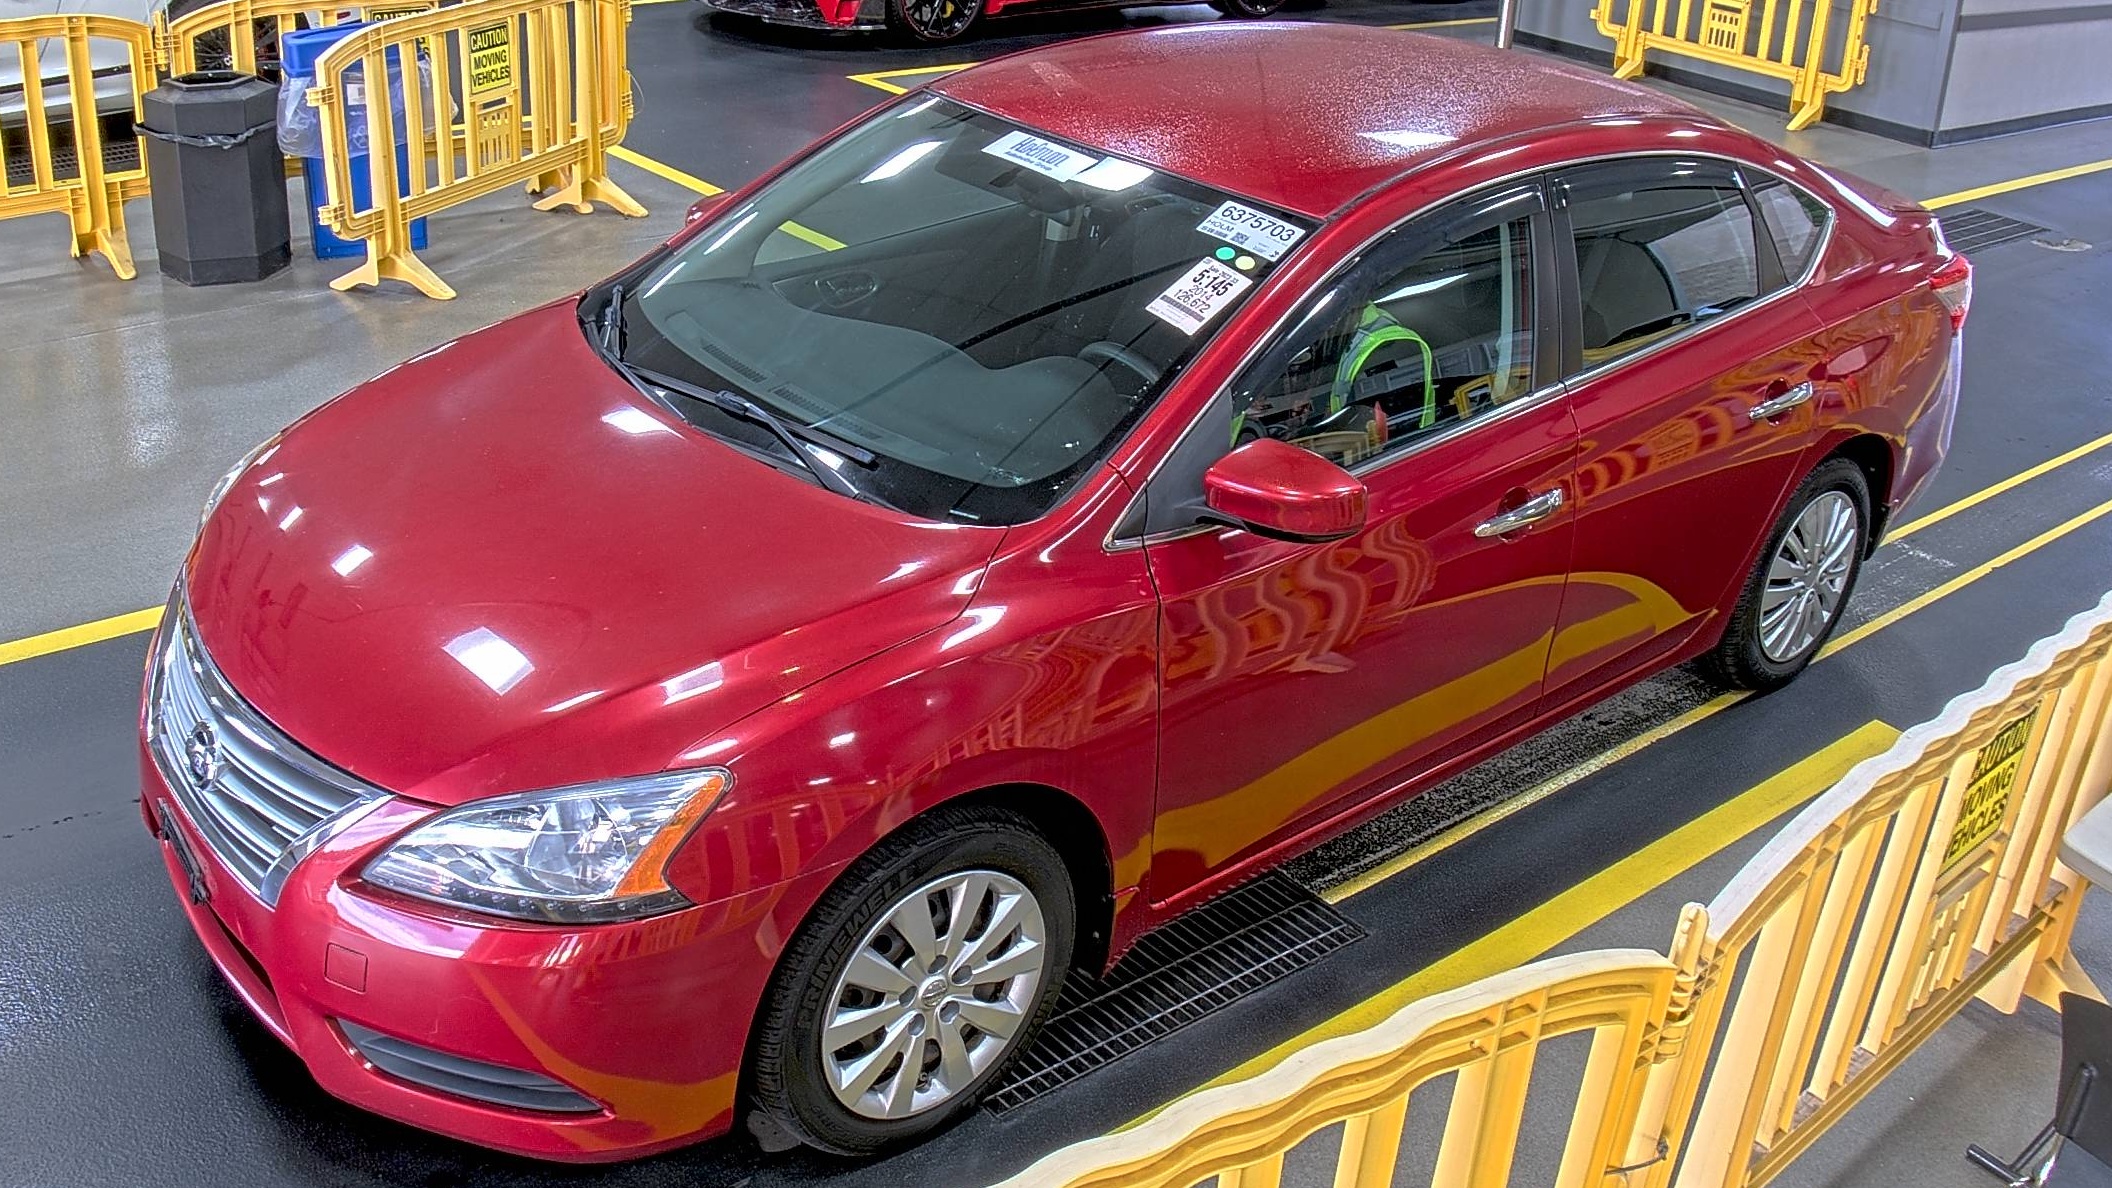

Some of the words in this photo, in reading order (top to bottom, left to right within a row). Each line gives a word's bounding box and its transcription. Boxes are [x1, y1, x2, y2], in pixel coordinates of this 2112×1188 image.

[470, 26, 507, 51] CAUTION
[474, 49, 507, 70] MOVING
[472, 65, 510, 87] VEHICLES
[1221, 206, 1295, 241] 6375703
[1189, 285, 1213, 300] 2014
[1193, 269, 1233, 296] 5:145
